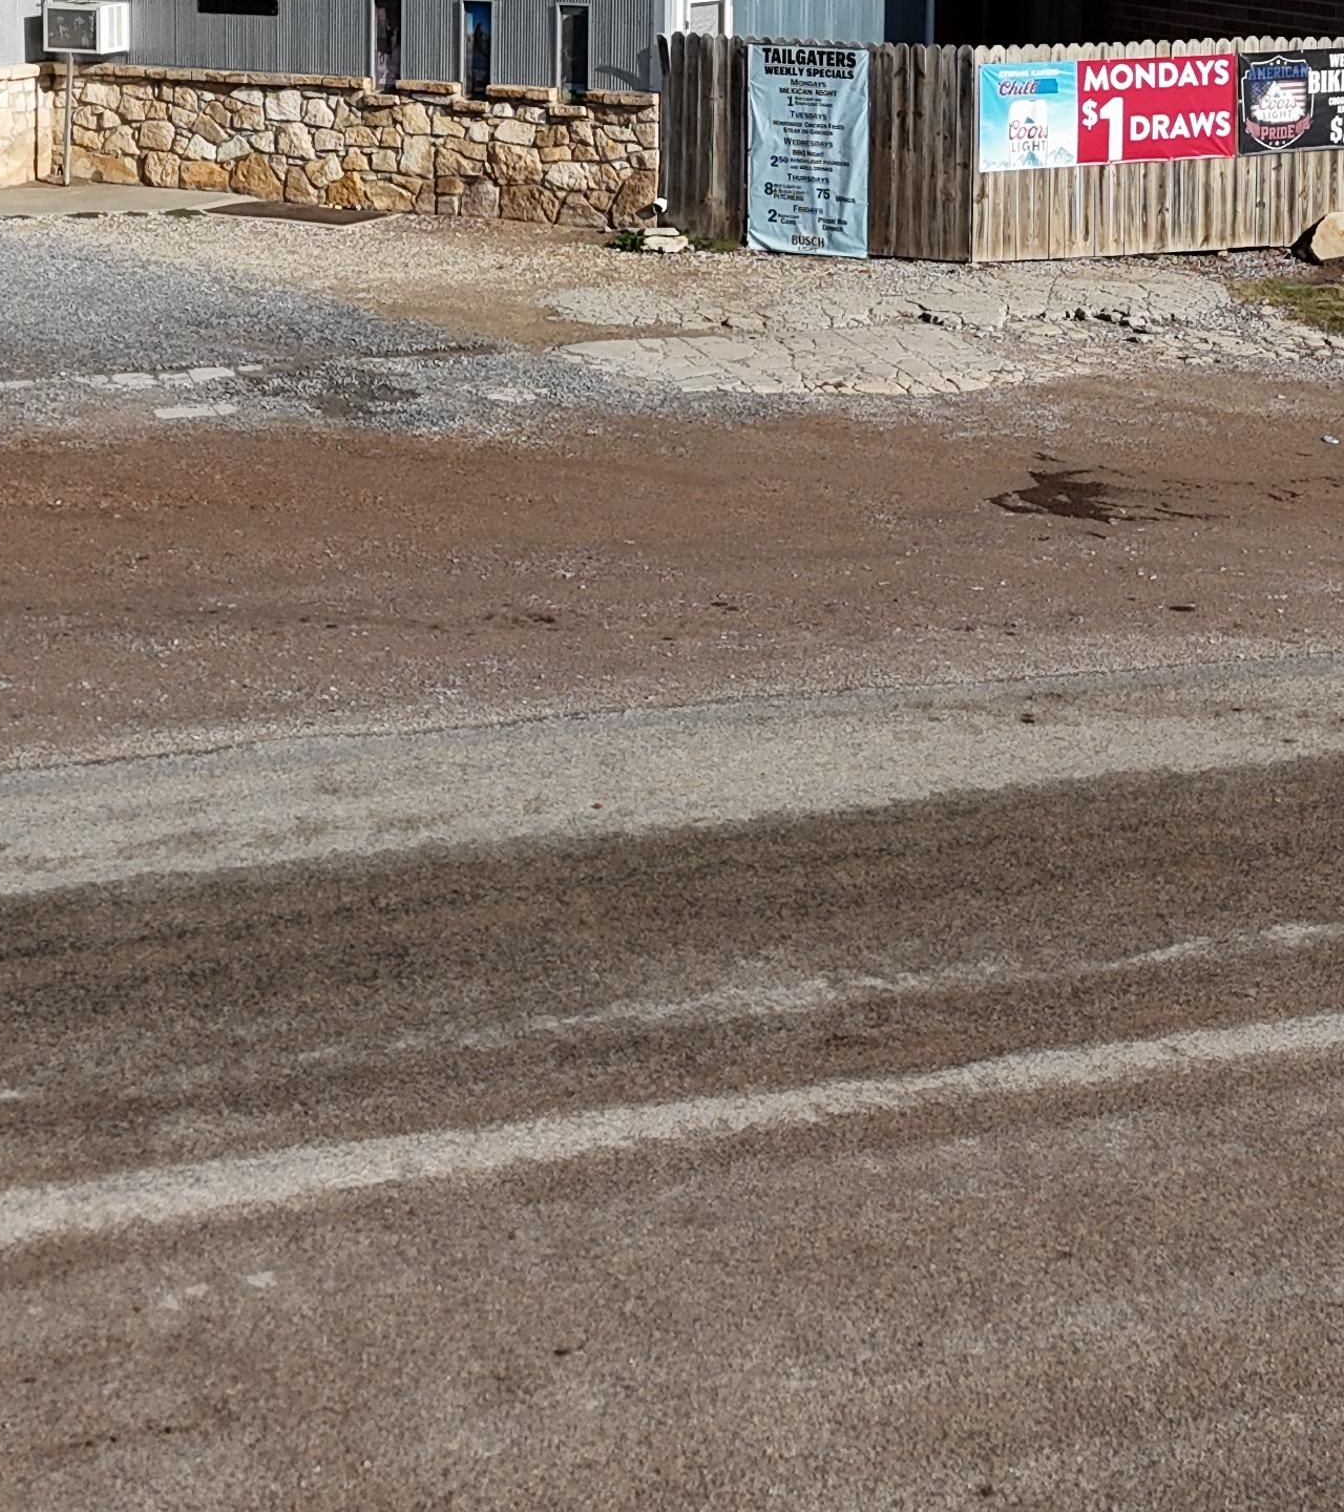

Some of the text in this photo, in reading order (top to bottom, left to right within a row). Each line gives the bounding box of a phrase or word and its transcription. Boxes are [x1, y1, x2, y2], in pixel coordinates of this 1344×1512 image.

[762, 47, 857, 68] TAILGATERS
[764, 66, 854, 80] WEEKLY SPECIALS
[1084, 59, 1230, 92] MONDAYS
[1248, 63, 1309, 80] AMERICAN
[998, 78, 1040, 96] Chill
[787, 96, 794, 107] 1
[1258, 94, 1296, 111] Coors
[1262, 110, 1292, 119] LIGHT
[1008, 119, 1048, 140] Coors
[1082, 96, 1232, 161] $1 DRAWS
[1260, 124, 1296, 141] PRIDE
[1011, 140, 1046, 153] LIGHT
[764, 182, 774, 195] 8
[816, 188, 830, 200] 75
[767, 209, 777, 223] 2
[791, 234, 825, 248] BUSCH
